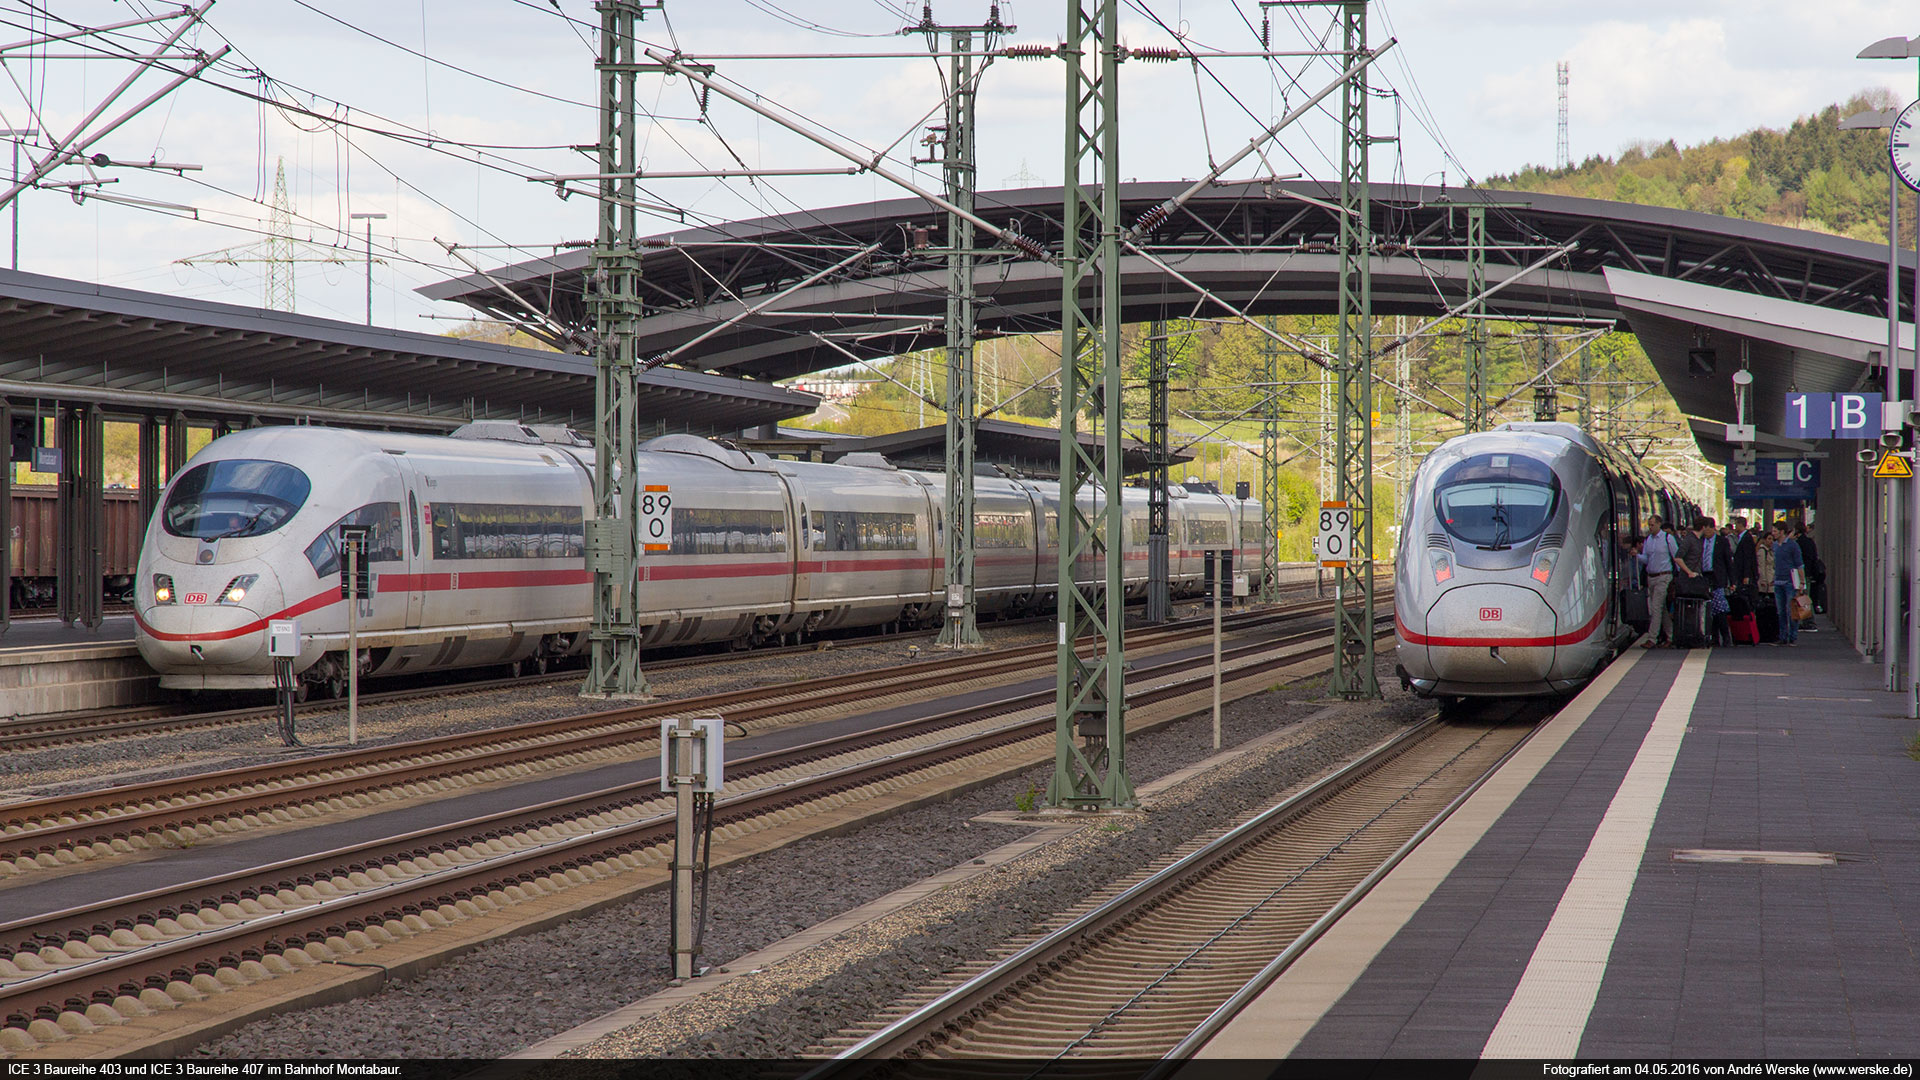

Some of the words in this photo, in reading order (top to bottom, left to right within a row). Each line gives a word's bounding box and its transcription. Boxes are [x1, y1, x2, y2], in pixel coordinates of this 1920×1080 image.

[1792, 395, 1807, 429] 1
[1842, 395, 1867, 429] B
[1796, 460, 1812, 482] C
[642, 495, 672, 515] 89
[649, 518, 665, 538] 0
[1320, 511, 1350, 531] 89
[1327, 535, 1343, 555] 0
[186, 594, 205, 603] DB
[1481, 609, 1501, 620] DB
